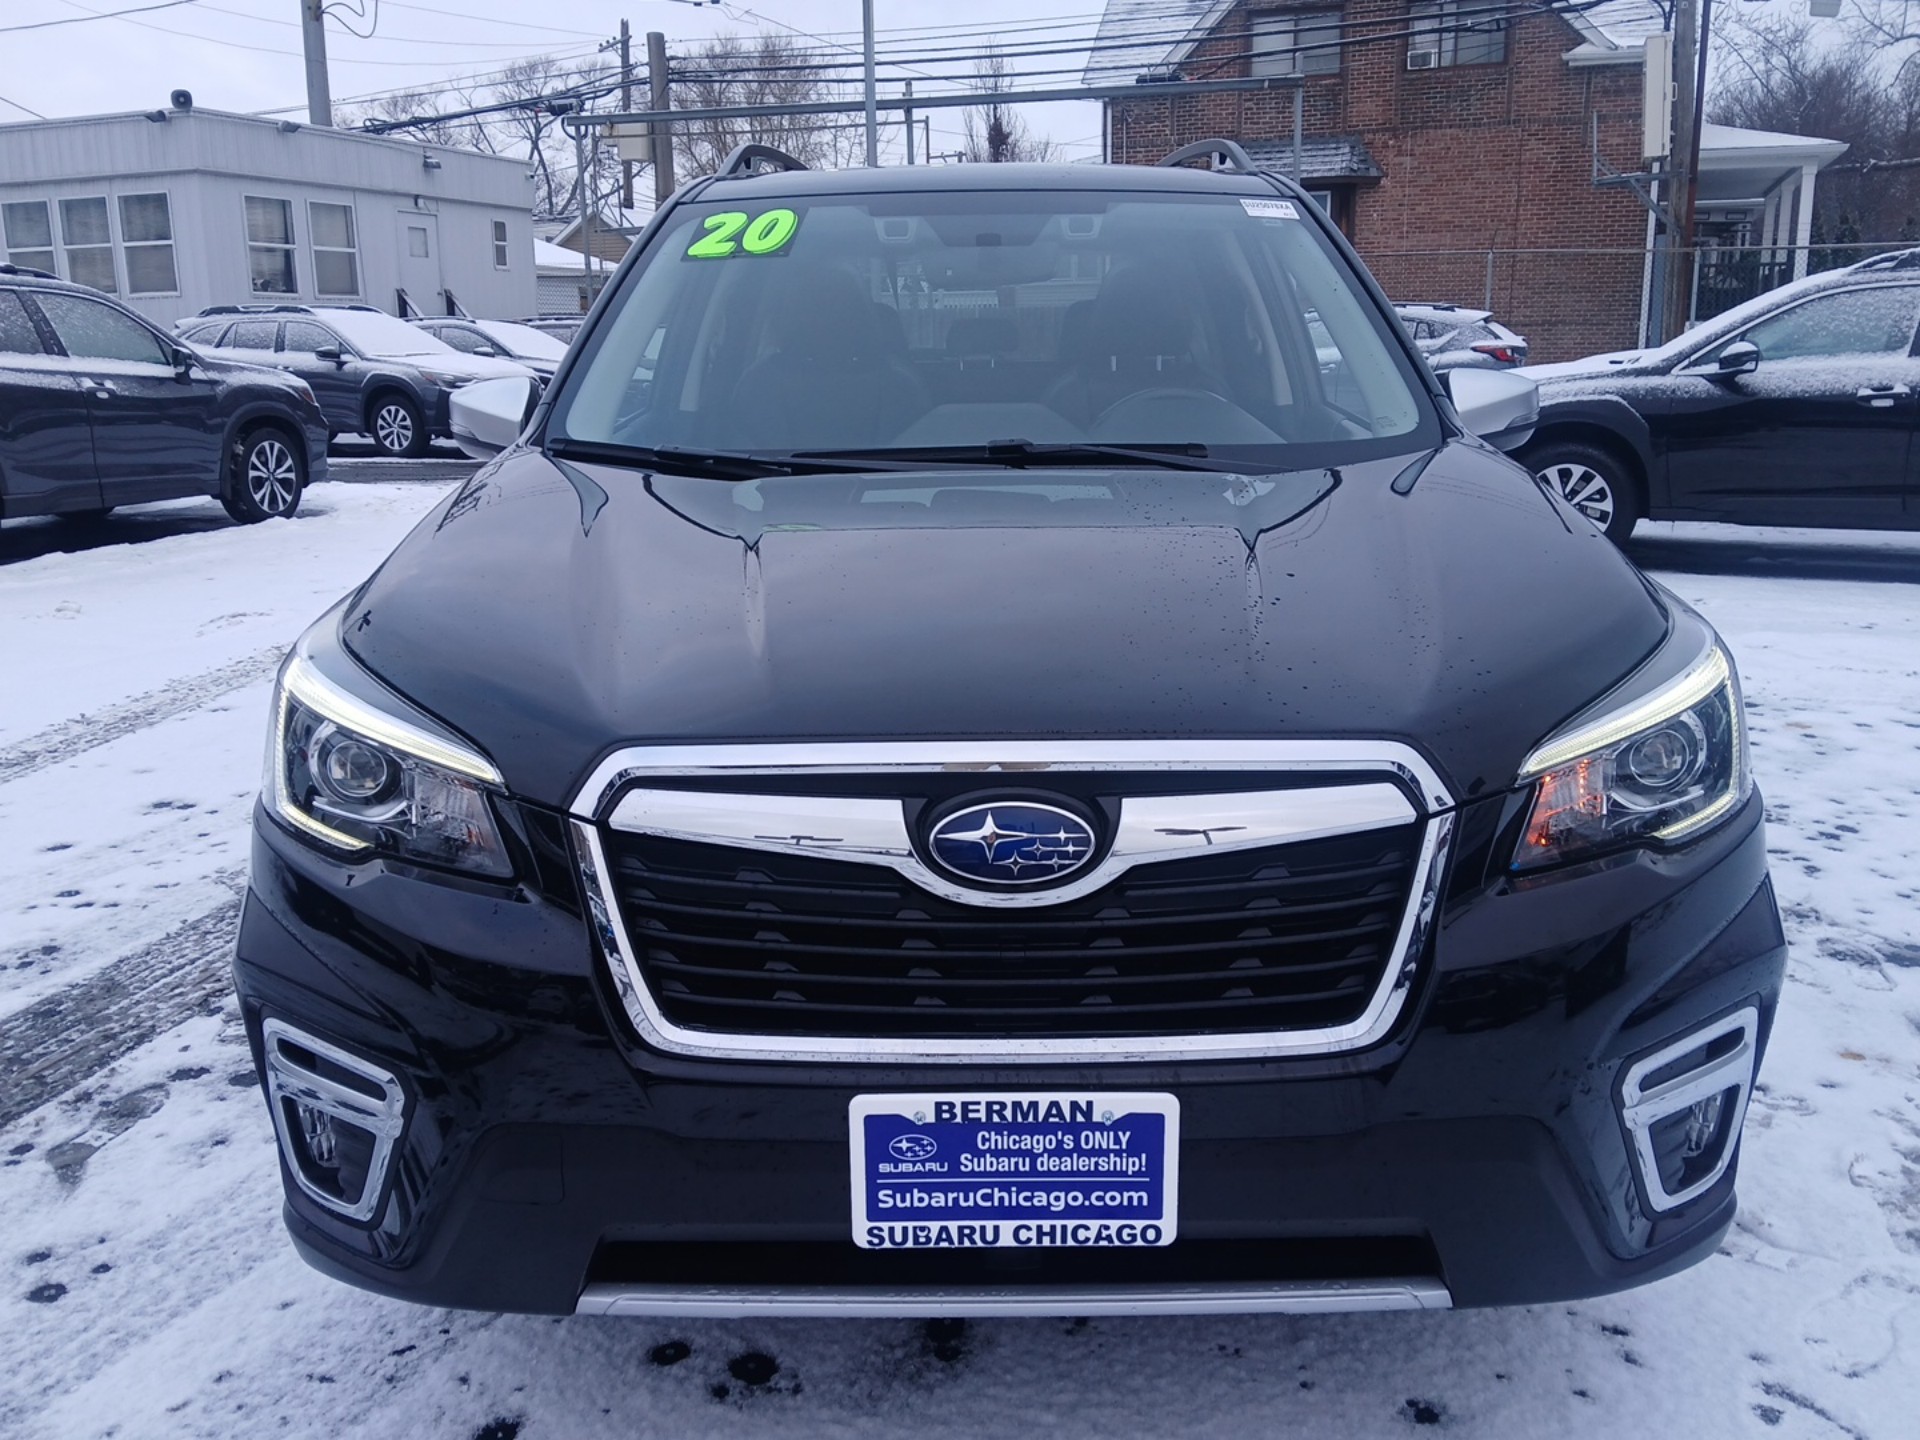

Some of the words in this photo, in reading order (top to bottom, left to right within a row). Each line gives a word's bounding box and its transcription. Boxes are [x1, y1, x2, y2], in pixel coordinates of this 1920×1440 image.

[687, 208, 798, 258] 20
[934, 1100, 1094, 1123] BERMAN
[977, 1131, 1074, 1152] Chicago's
[1080, 1131, 1131, 1150] ONLY
[878, 1162, 948, 1173] SUBARU
[959, 1153, 1030, 1172] Subaru
[1036, 1152, 1146, 1175] dealership!
[877, 1187, 1149, 1212] SubaruChicago.com
[866, 1225, 1001, 1247] SUBARU
[1012, 1223, 1162, 1246] CHICAGO
